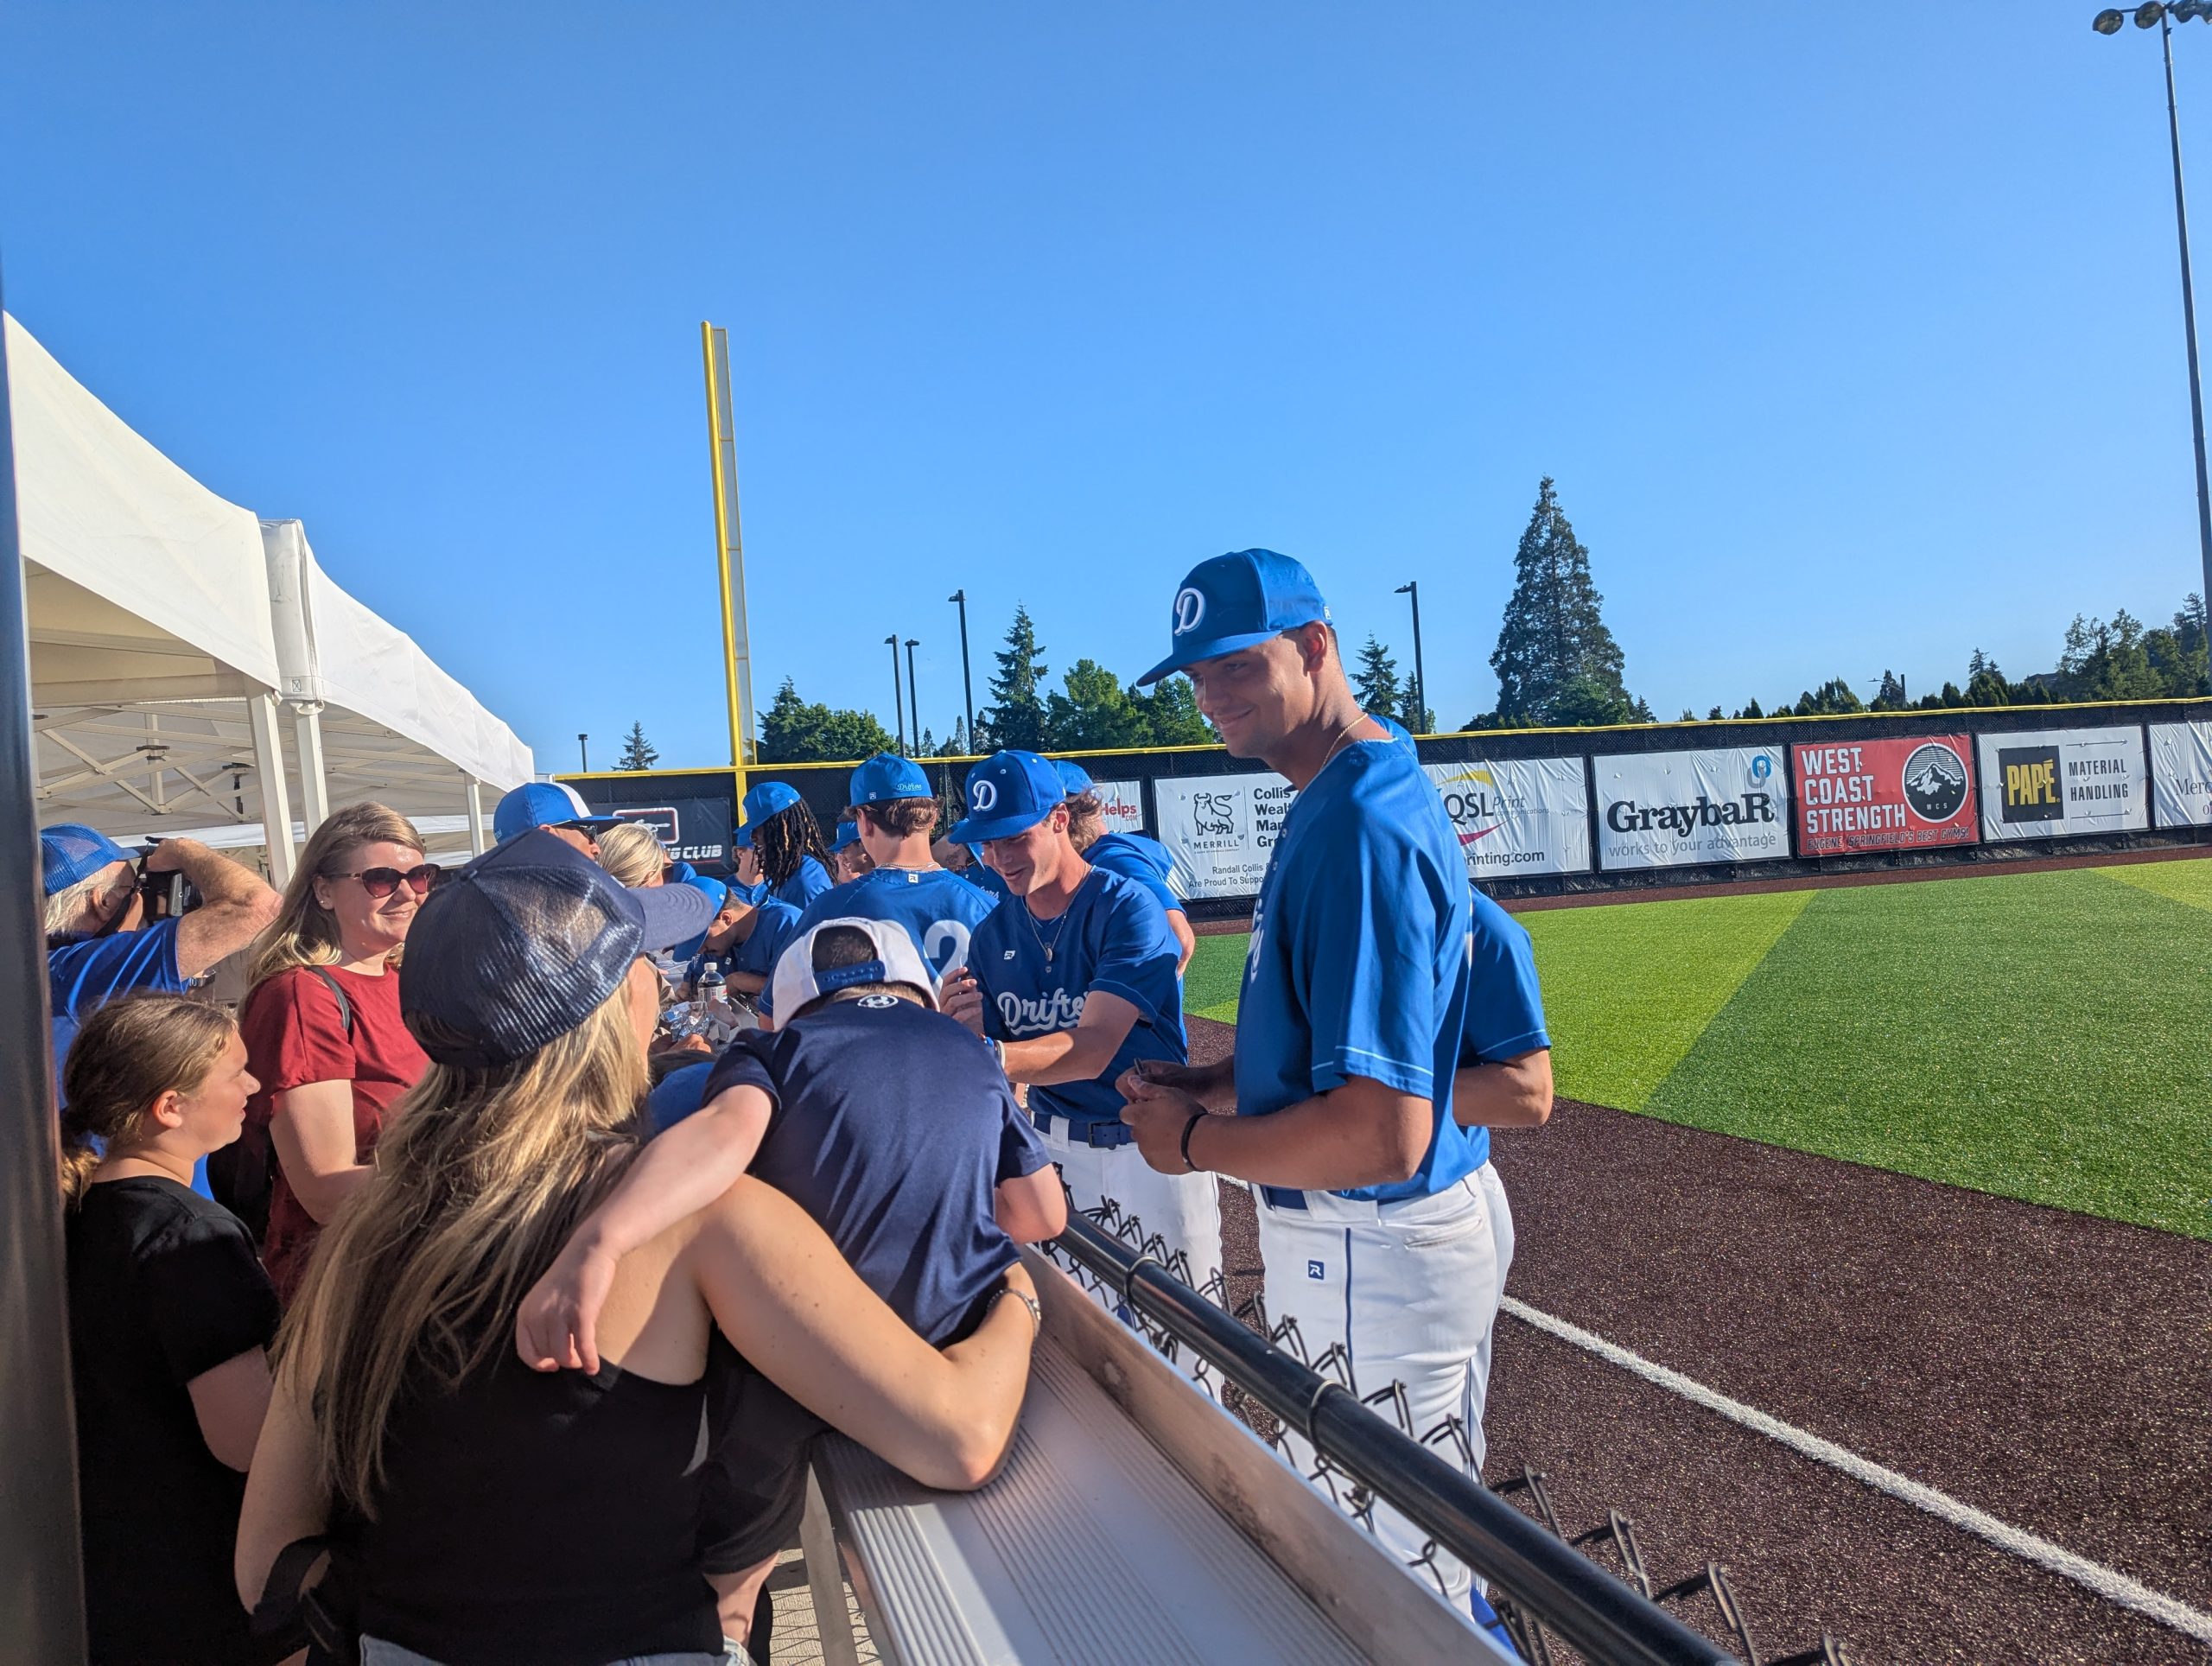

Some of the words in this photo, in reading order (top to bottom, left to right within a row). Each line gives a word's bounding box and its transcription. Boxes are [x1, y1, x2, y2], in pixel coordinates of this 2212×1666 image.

[1174, 588, 1205, 637] D
[1802, 747, 1862, 776] WEST
[2069, 759, 2127, 777] MATERIAL
[1253, 786, 1291, 800] Collis
[1804, 775, 1874, 805] COAST
[2005, 759, 2056, 806] PAPÉ
[2069, 783, 2129, 802] HANDLING
[973, 779, 998, 811] D
[1444, 792, 1494, 826] QSL
[1607, 792, 1775, 837] GraybaR
[1806, 804, 1906, 834] STRENGTH
[1193, 839, 1239, 849] MERRILL
[1609, 843, 1649, 857] works
[1655, 842, 1668, 854] to
[1672, 839, 1702, 855] your
[1707, 833, 1777, 850] advantage
[1916, 830, 1938, 843] BEST
[683, 844, 722, 861] CLUB
[1465, 851, 1545, 867] rinting.com
[1212, 865, 1240, 874] Randall
[1242, 863, 1263, 873] Collis
[1188, 880, 1203, 888] Are
[1204, 878, 1227, 887] Proud
[1228, 876, 1238, 885] To
[1239, 875, 1264, 886] Suppo
[997, 988, 1088, 1036] Drifte
